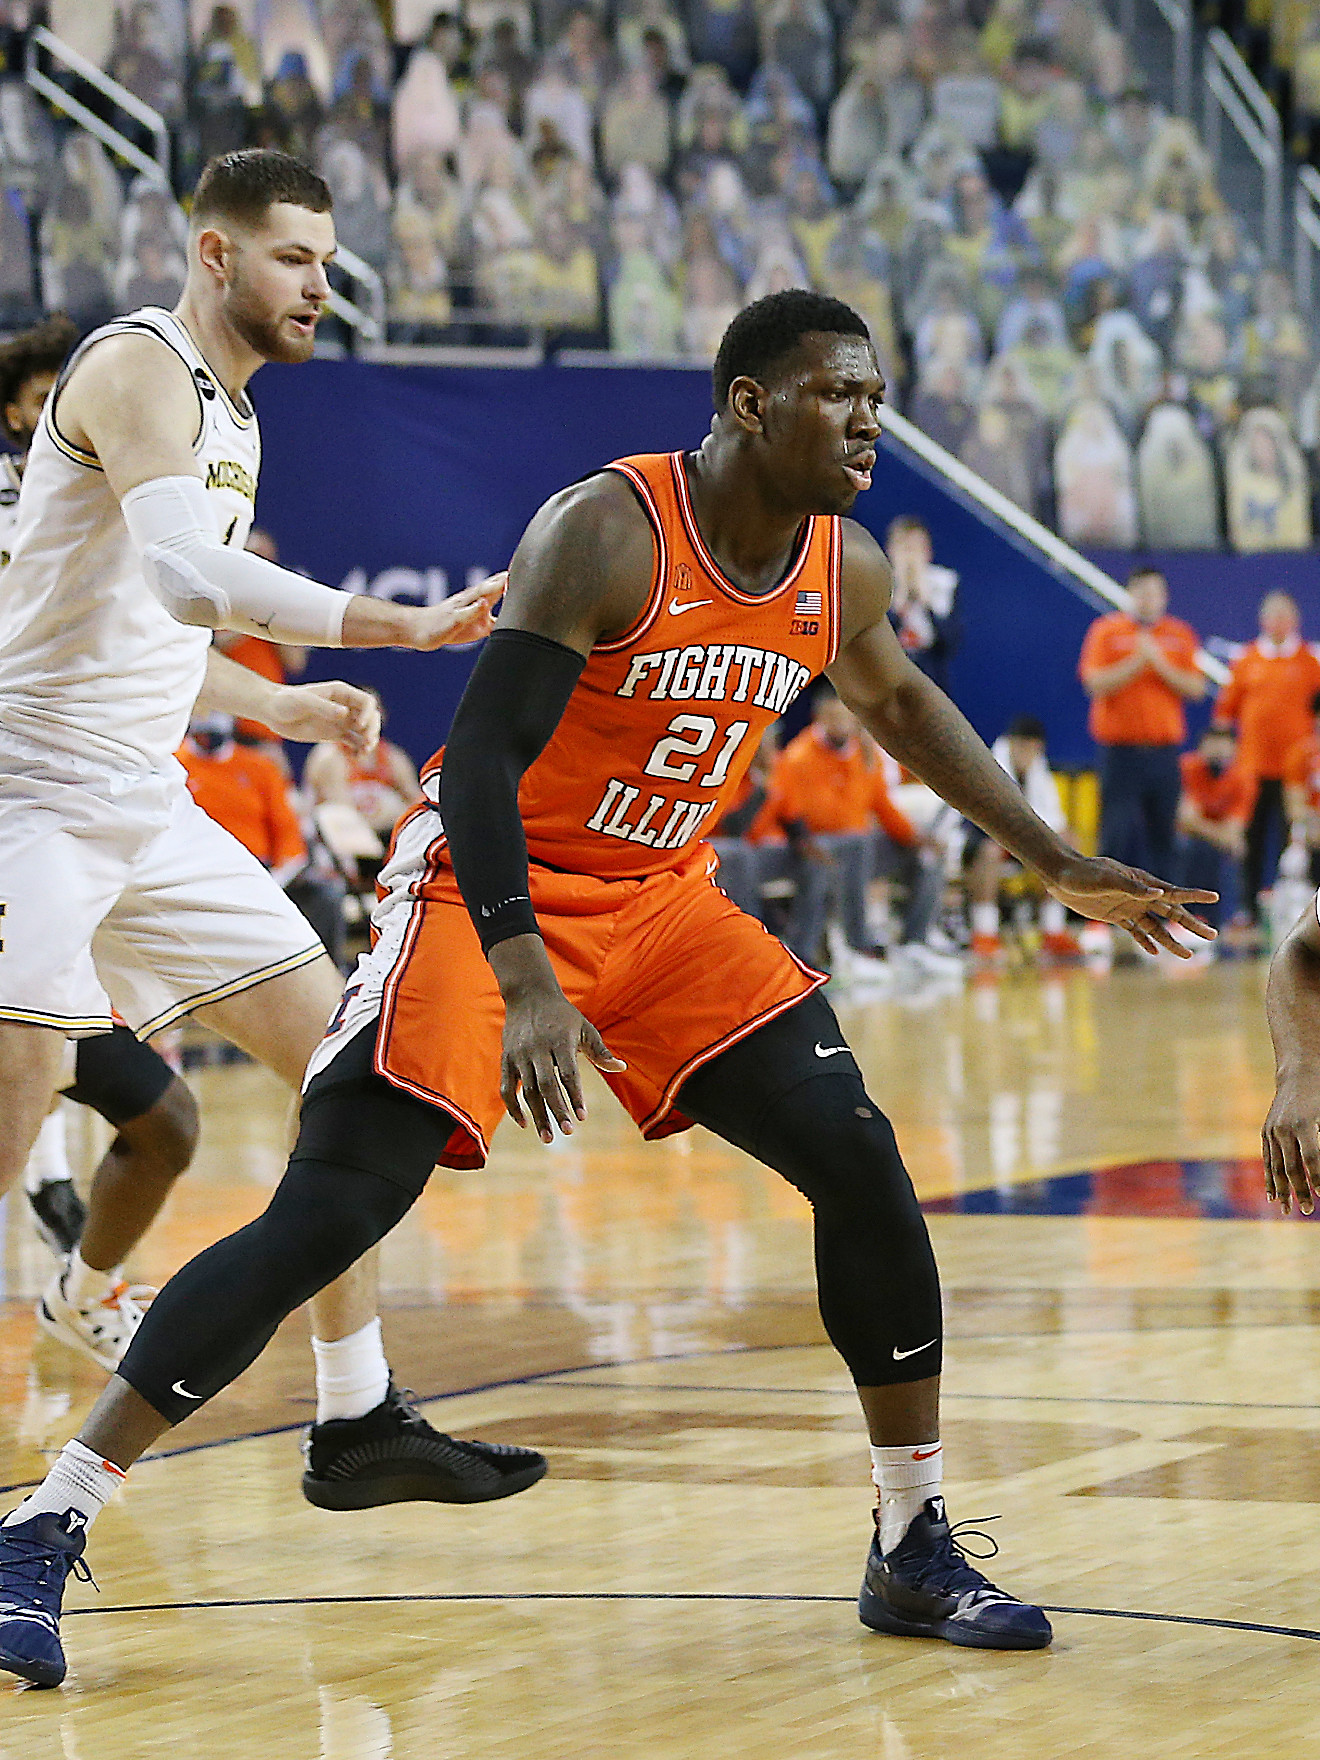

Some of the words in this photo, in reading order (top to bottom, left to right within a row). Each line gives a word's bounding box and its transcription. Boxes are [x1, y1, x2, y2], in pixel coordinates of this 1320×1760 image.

[615, 644, 811, 714] FIGHTING
[644, 713, 749, 787] 21
[584, 777, 717, 848] ILLIN
